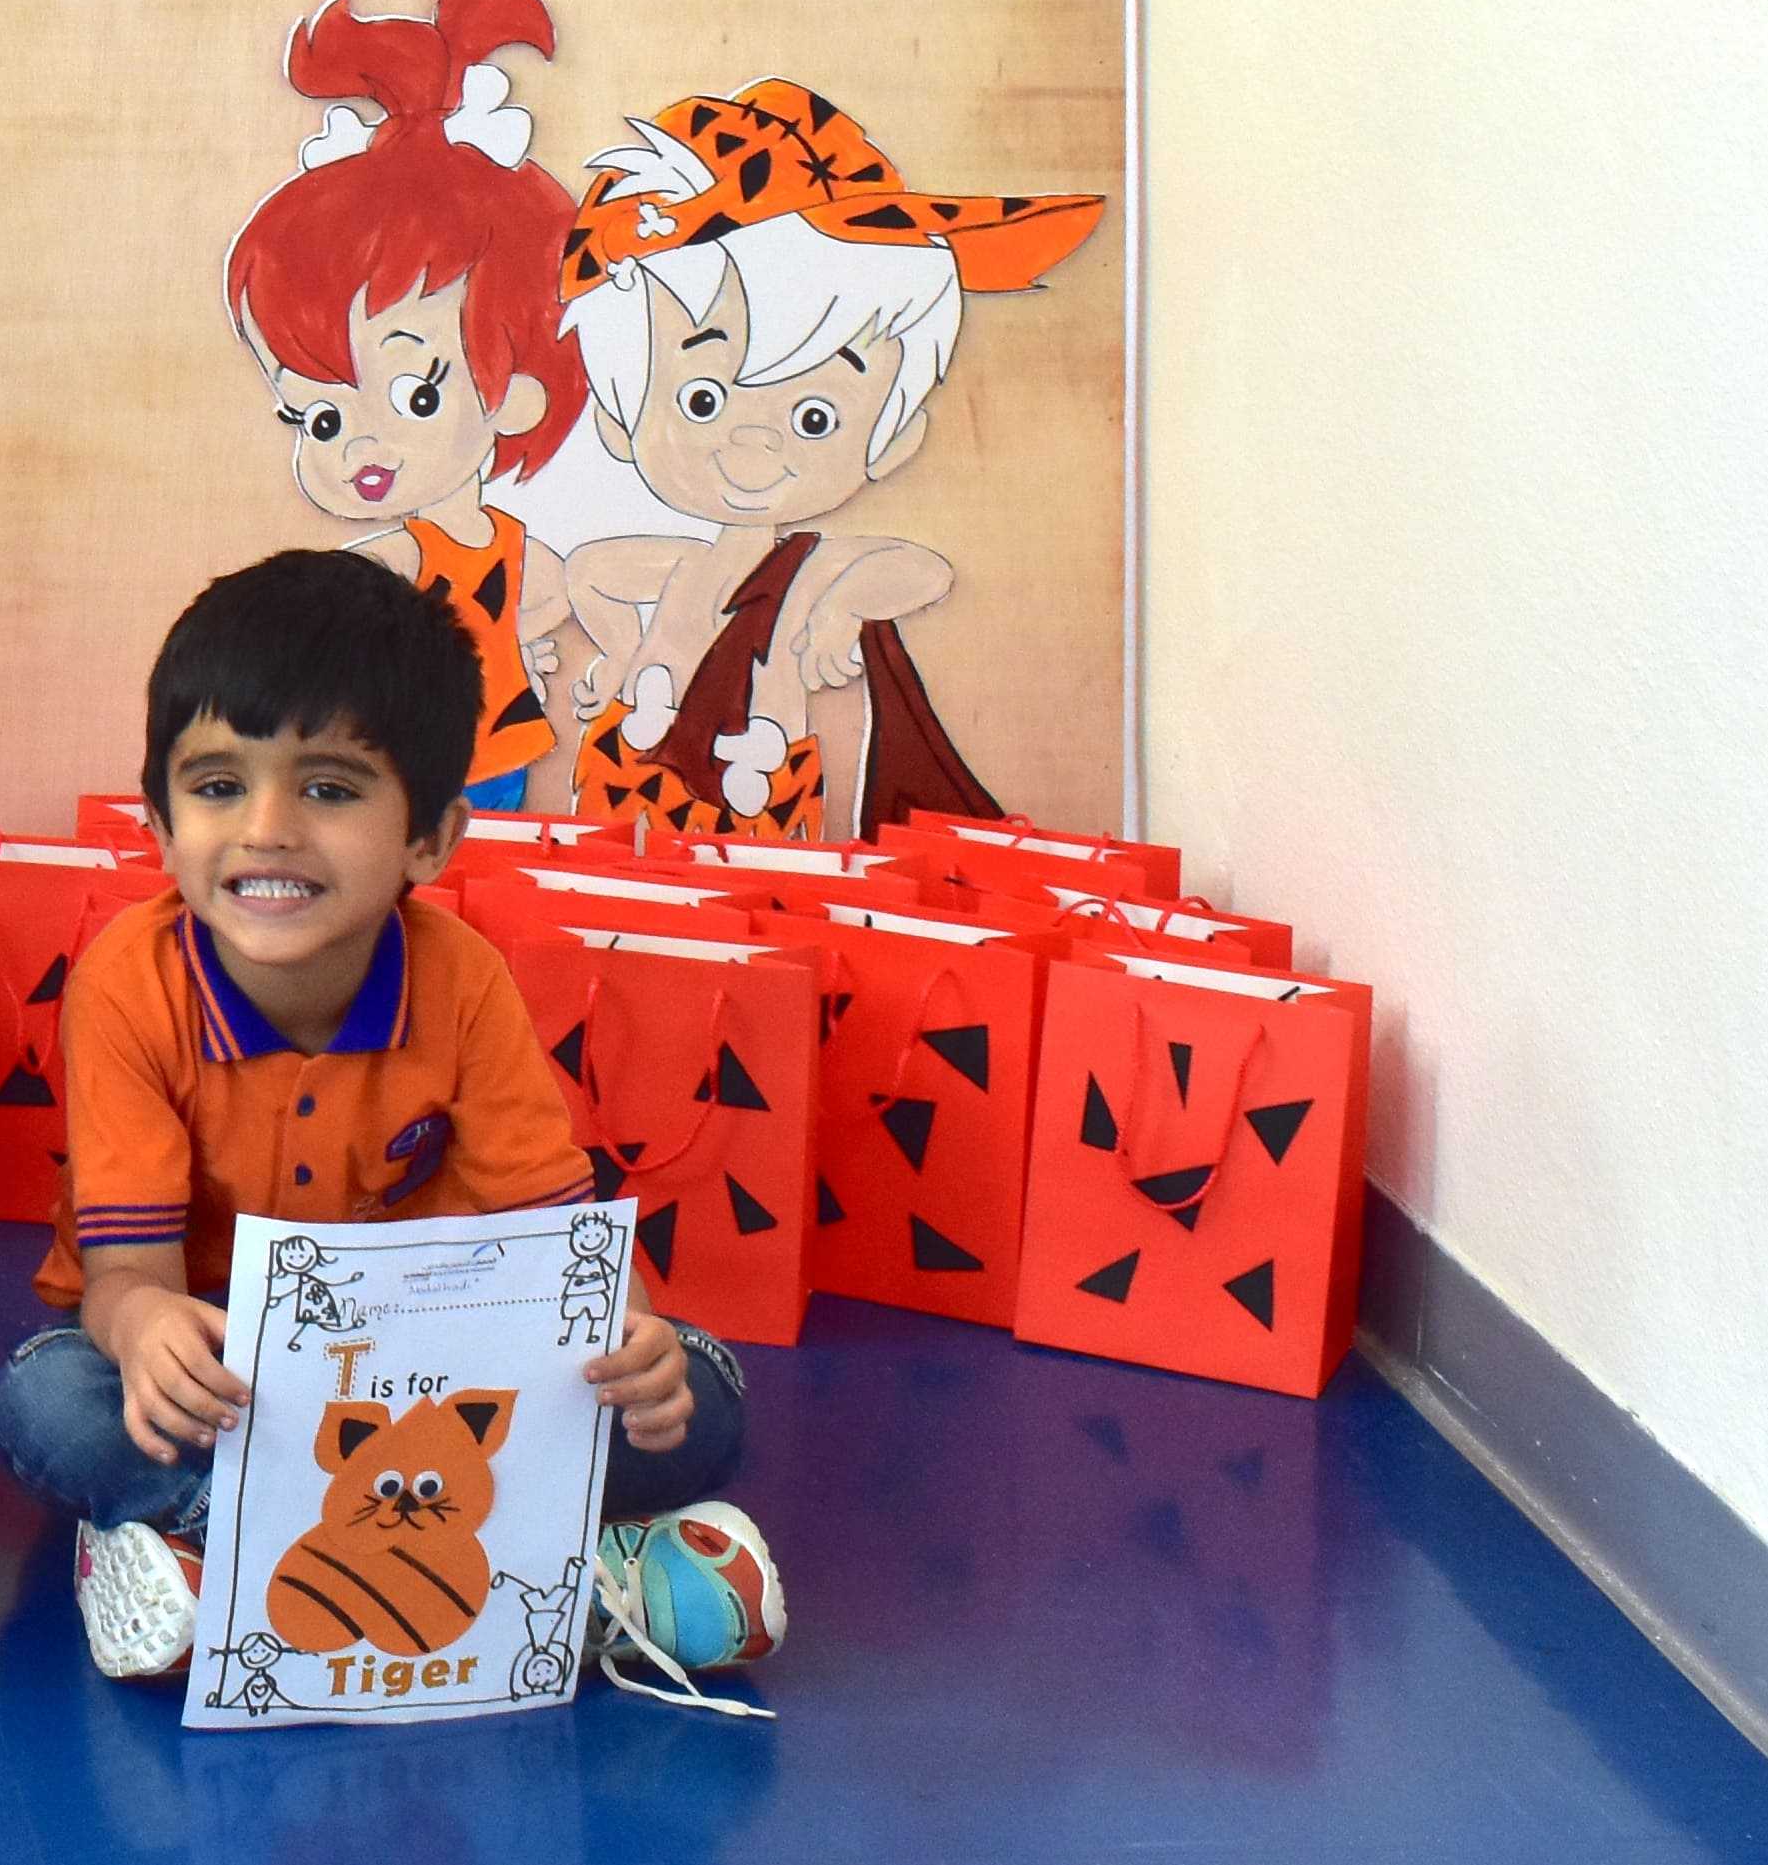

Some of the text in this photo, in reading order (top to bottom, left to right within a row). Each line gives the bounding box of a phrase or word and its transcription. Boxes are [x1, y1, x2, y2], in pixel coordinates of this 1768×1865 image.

[324, 1336, 449, 1400] T is for
[324, 1650, 480, 1698] Tiger
